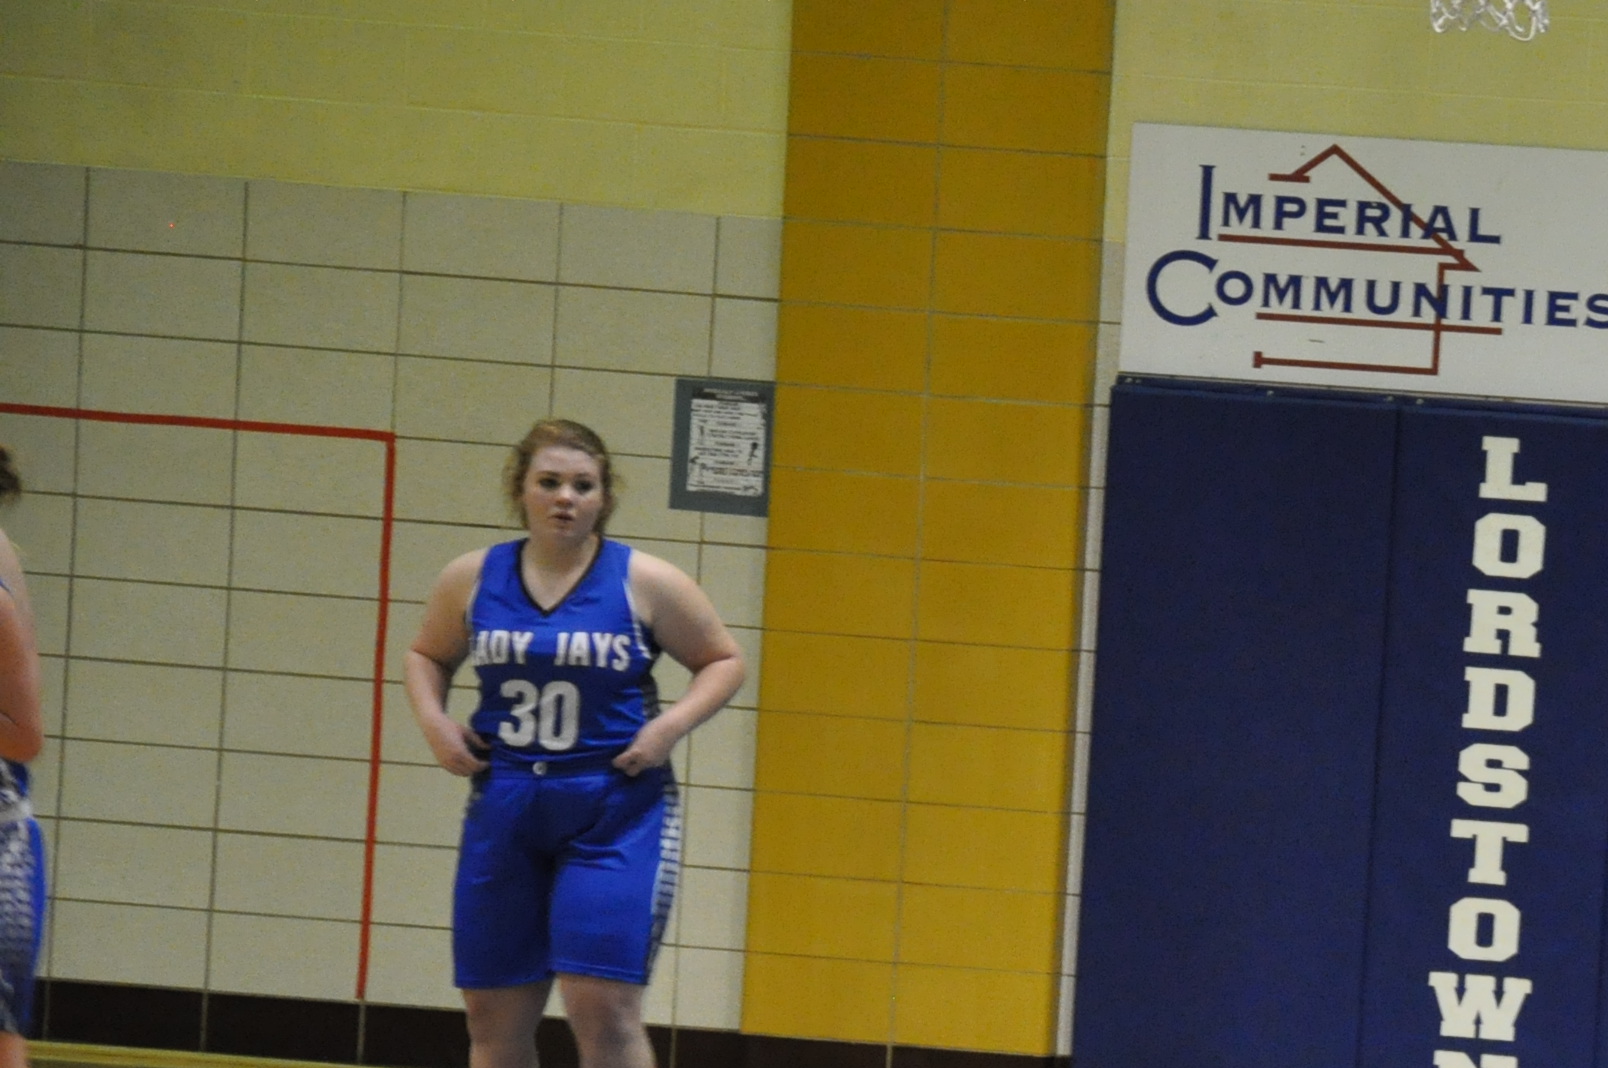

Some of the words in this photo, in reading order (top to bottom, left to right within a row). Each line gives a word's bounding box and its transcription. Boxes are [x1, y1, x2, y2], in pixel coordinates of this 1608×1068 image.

[1195, 164, 1502, 244] IMPERIAL
[473, 629, 535, 667] ADY
[554, 631, 631, 672] JAYS
[498, 678, 580, 751] 30
